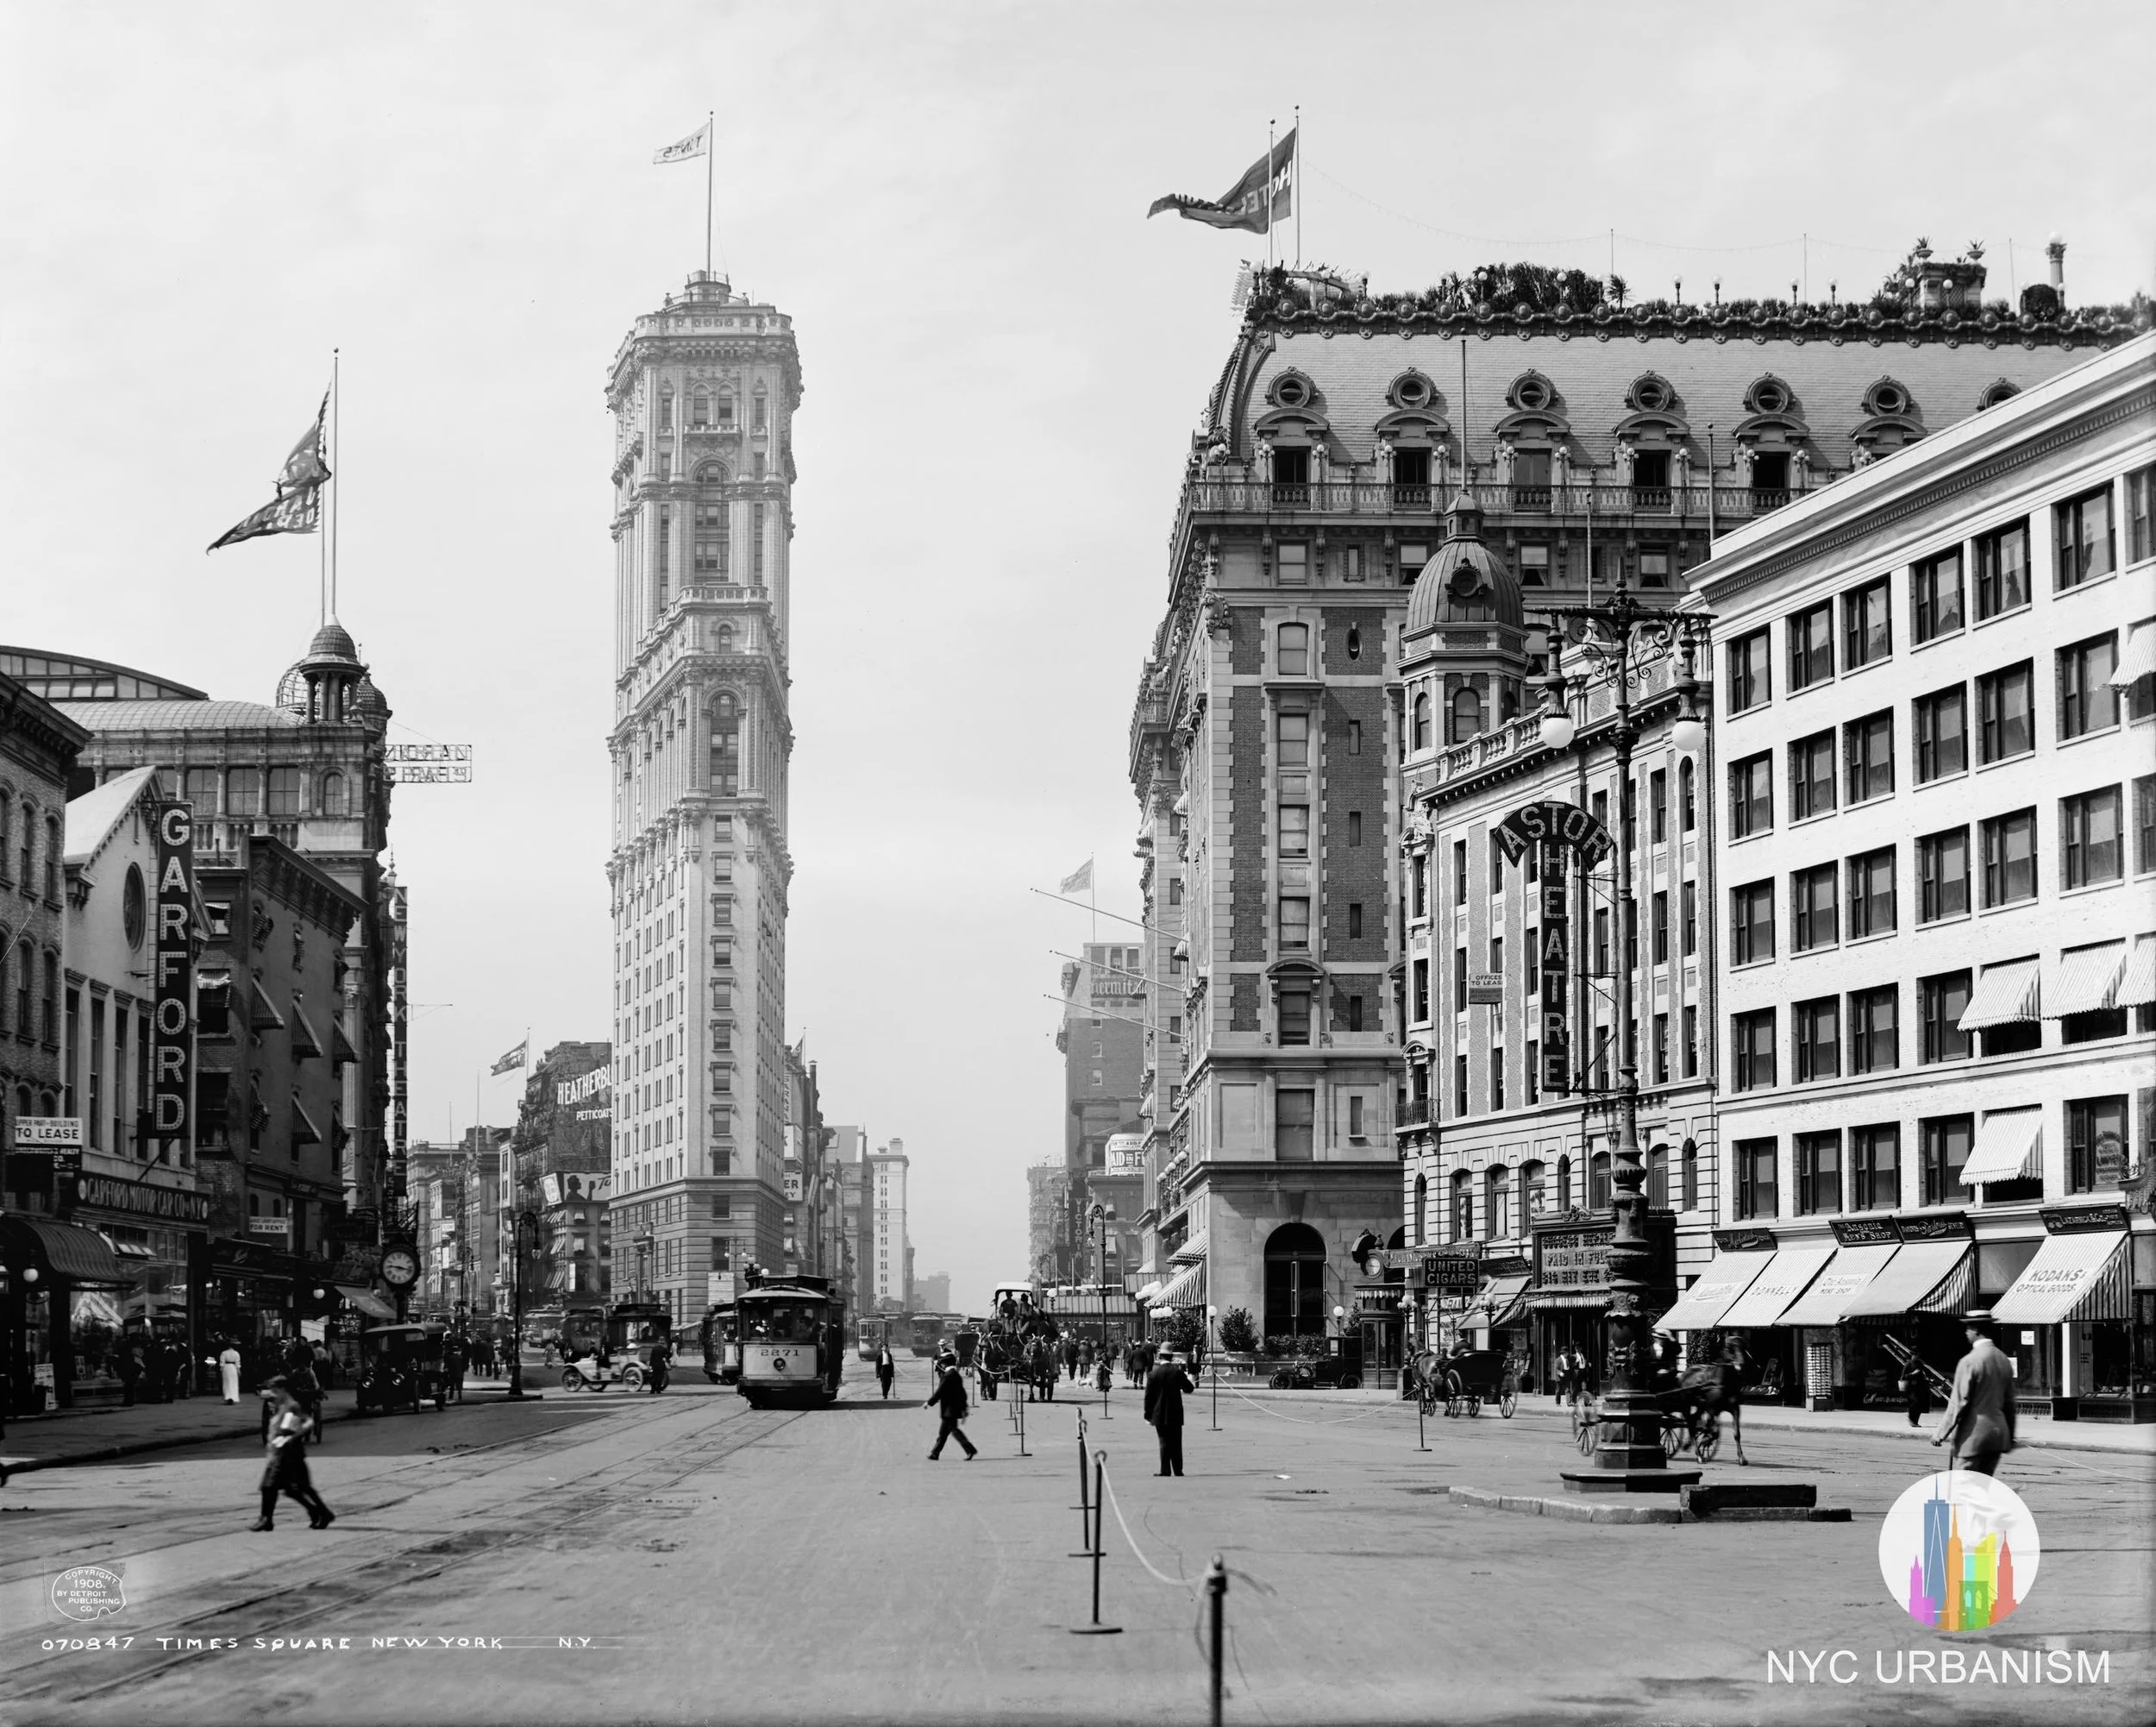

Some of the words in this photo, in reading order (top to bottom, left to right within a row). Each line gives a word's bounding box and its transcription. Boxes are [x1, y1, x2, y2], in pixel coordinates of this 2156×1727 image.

[1499, 802, 1612, 862] ASTOR
[393, 887, 407, 941] NEW
[157, 808, 189, 1131] GARFORD
[394, 947, 407, 1022] YORK
[393, 1041, 407, 1177] THEATRE
[16, 1127, 32, 1138] TO
[38, 1128, 79, 1140] LEASE
[128, 1185, 157, 1212] MOTOR
[157, 1190, 172, 1216] CAR
[1427, 1260, 1476, 1272] UNITED
[1548, 1253, 1568, 1266] PAID
[1575, 1253, 1584, 1265] IN
[1589, 1250, 1605, 1264] FUL
[1426, 1272, 1476, 1284] CIGARS
[2029, 1269, 2083, 1282] KODAKS
[2016, 1284, 2046, 1293] OPTICAL
